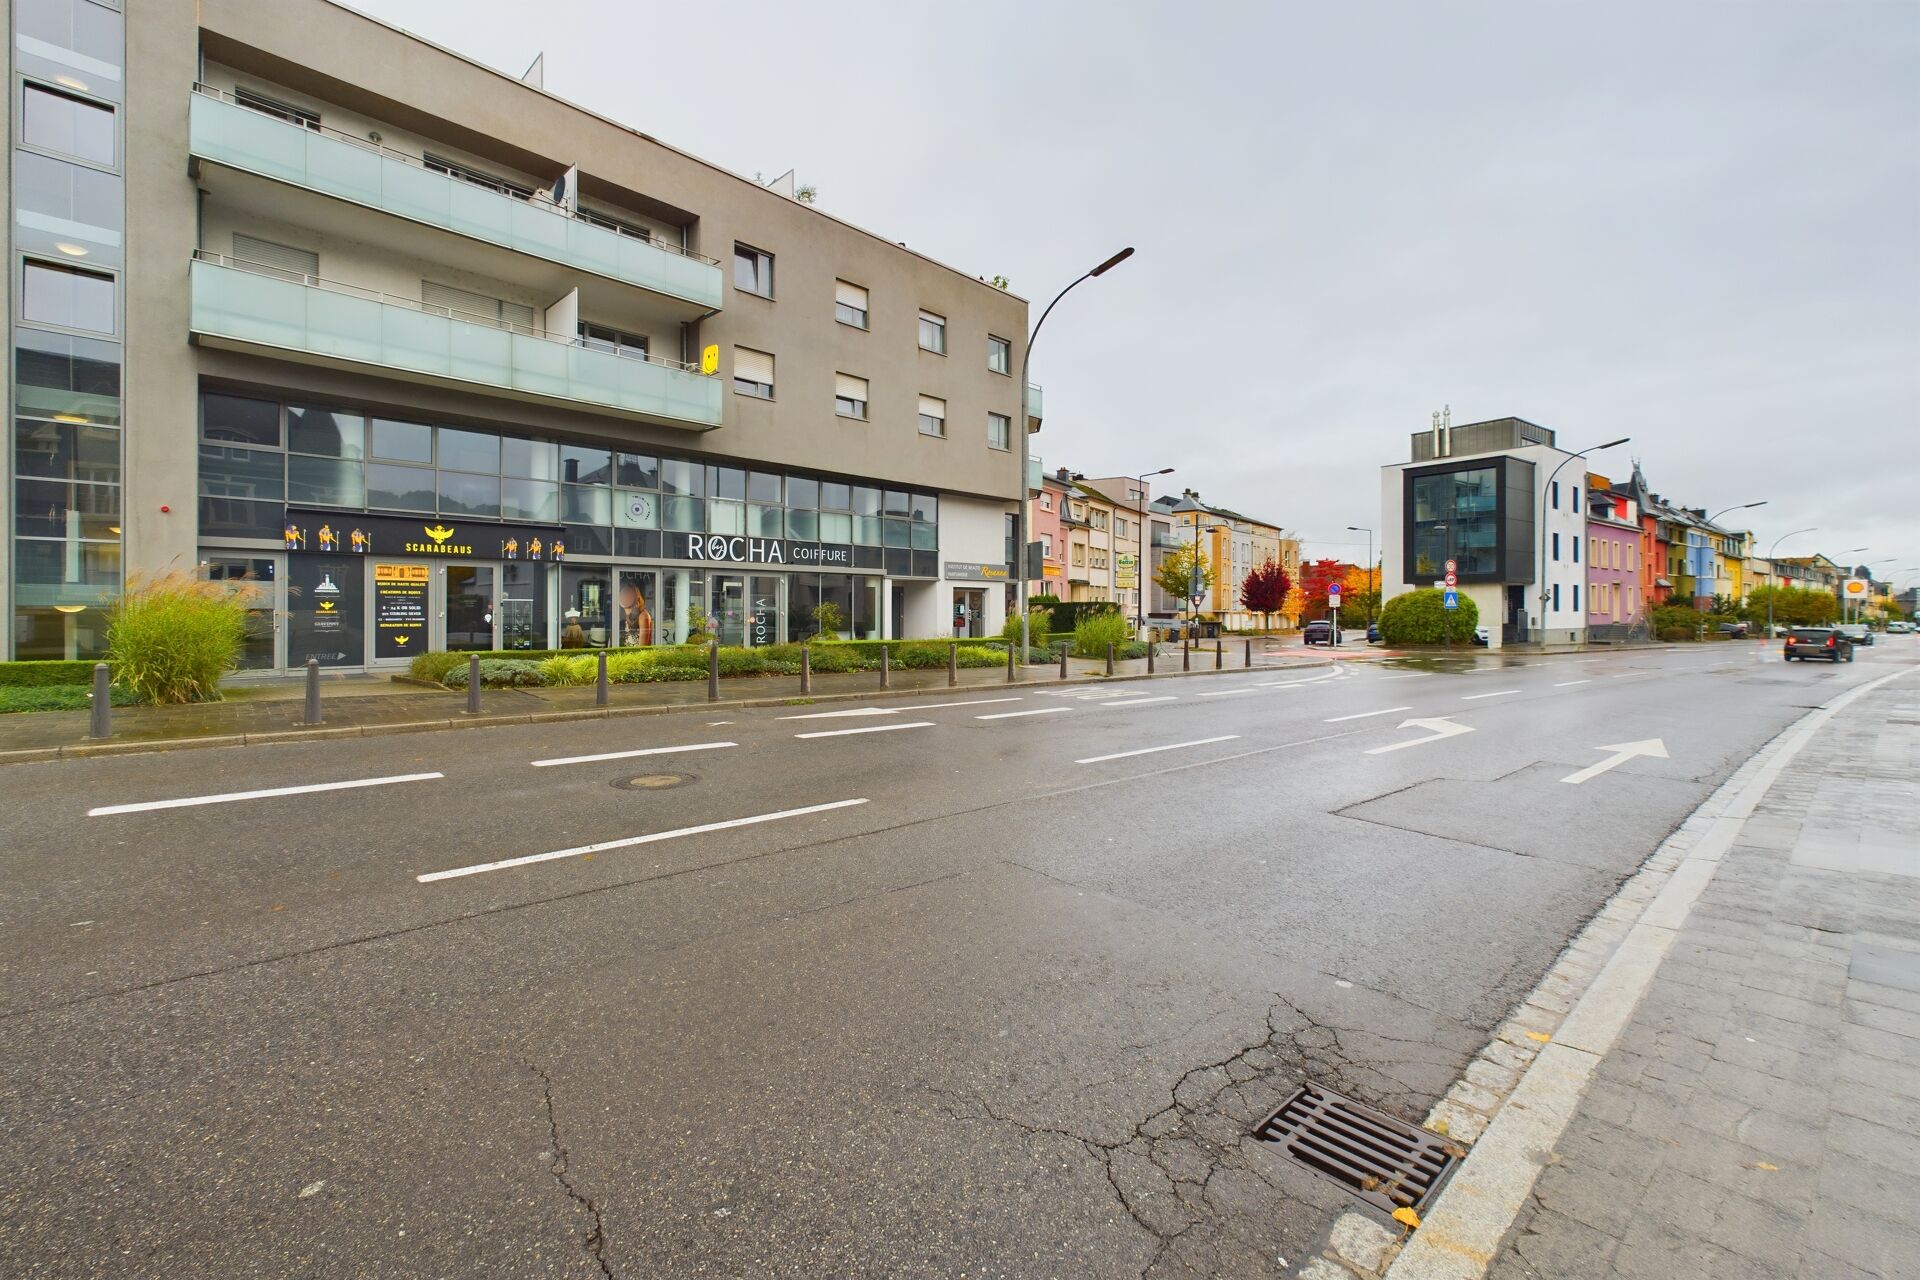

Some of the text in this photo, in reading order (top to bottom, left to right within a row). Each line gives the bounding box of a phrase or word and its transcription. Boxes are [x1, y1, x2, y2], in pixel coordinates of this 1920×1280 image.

[405, 543, 472, 554] SCARABEAUS
[688, 534, 847, 564] ROCHA COIFFURE
[711, 538, 724, 557] by
[755, 598, 767, 644] ROCHA
